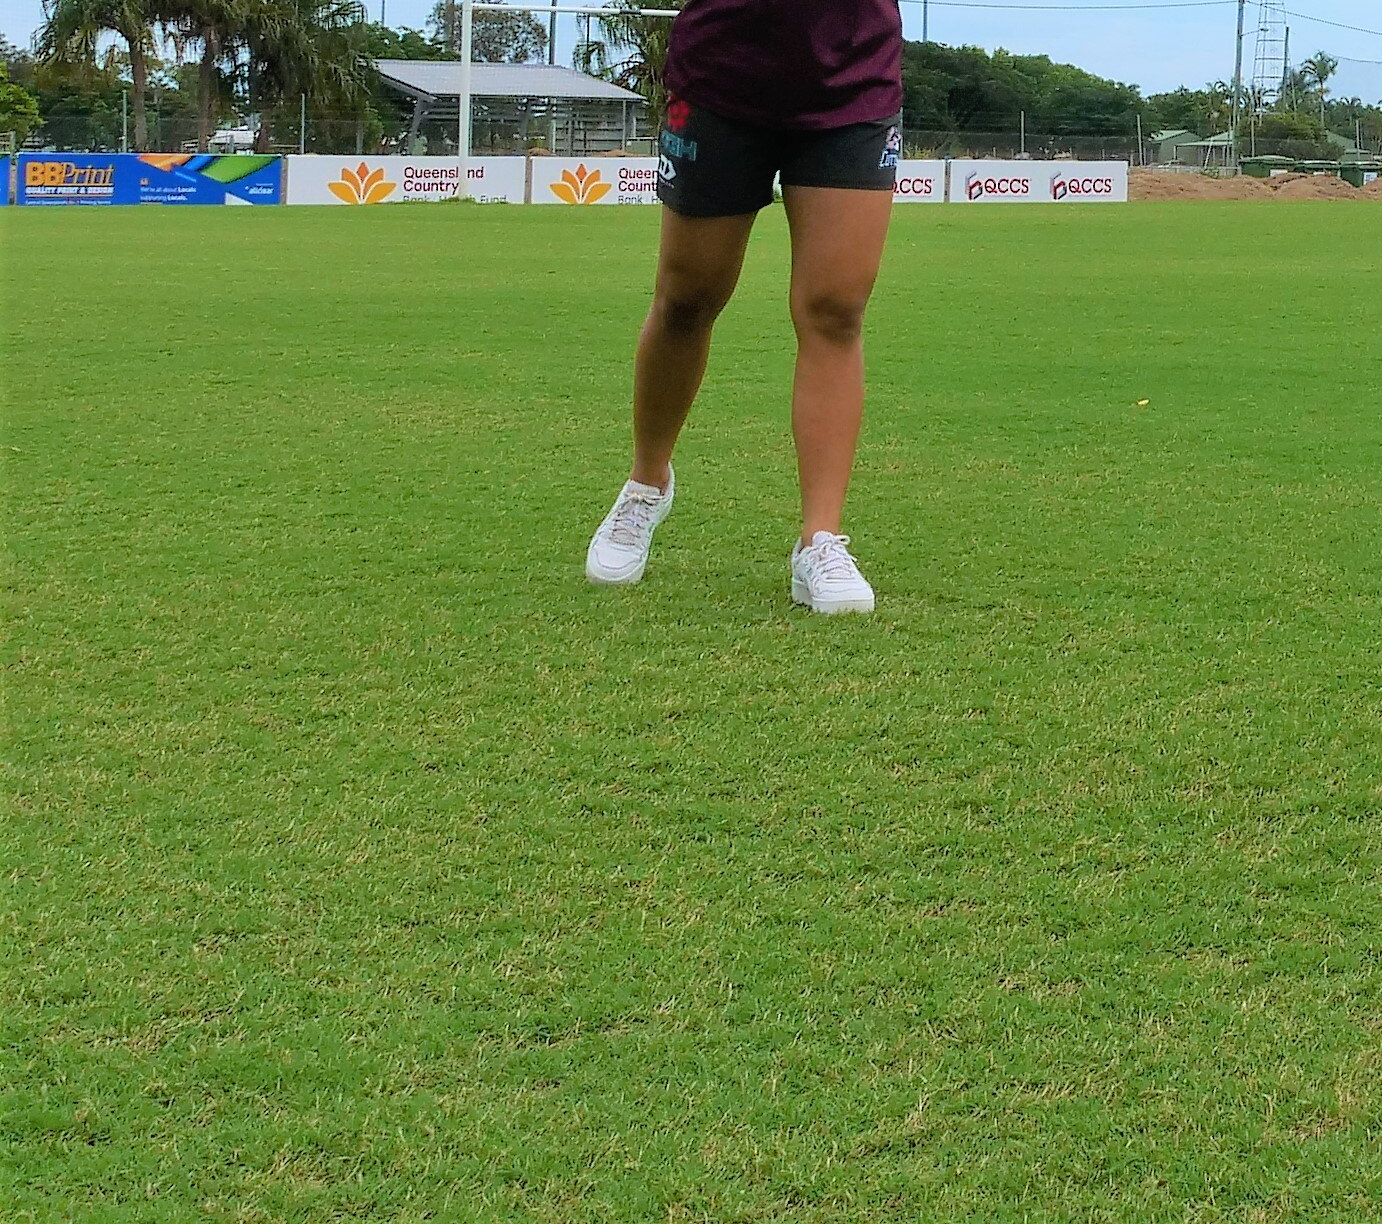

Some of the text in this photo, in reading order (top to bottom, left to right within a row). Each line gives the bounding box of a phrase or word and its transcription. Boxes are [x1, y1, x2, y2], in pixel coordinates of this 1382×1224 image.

[25, 162, 115, 186] BBPrint
[404, 166, 485, 180] Queenslnd
[618, 167, 659, 179] Queen
[403, 180, 460, 196] Country
[618, 181, 658, 192] Count
[984, 178, 1029, 194] QCCS
[1068, 178, 1112, 194] QCCS
